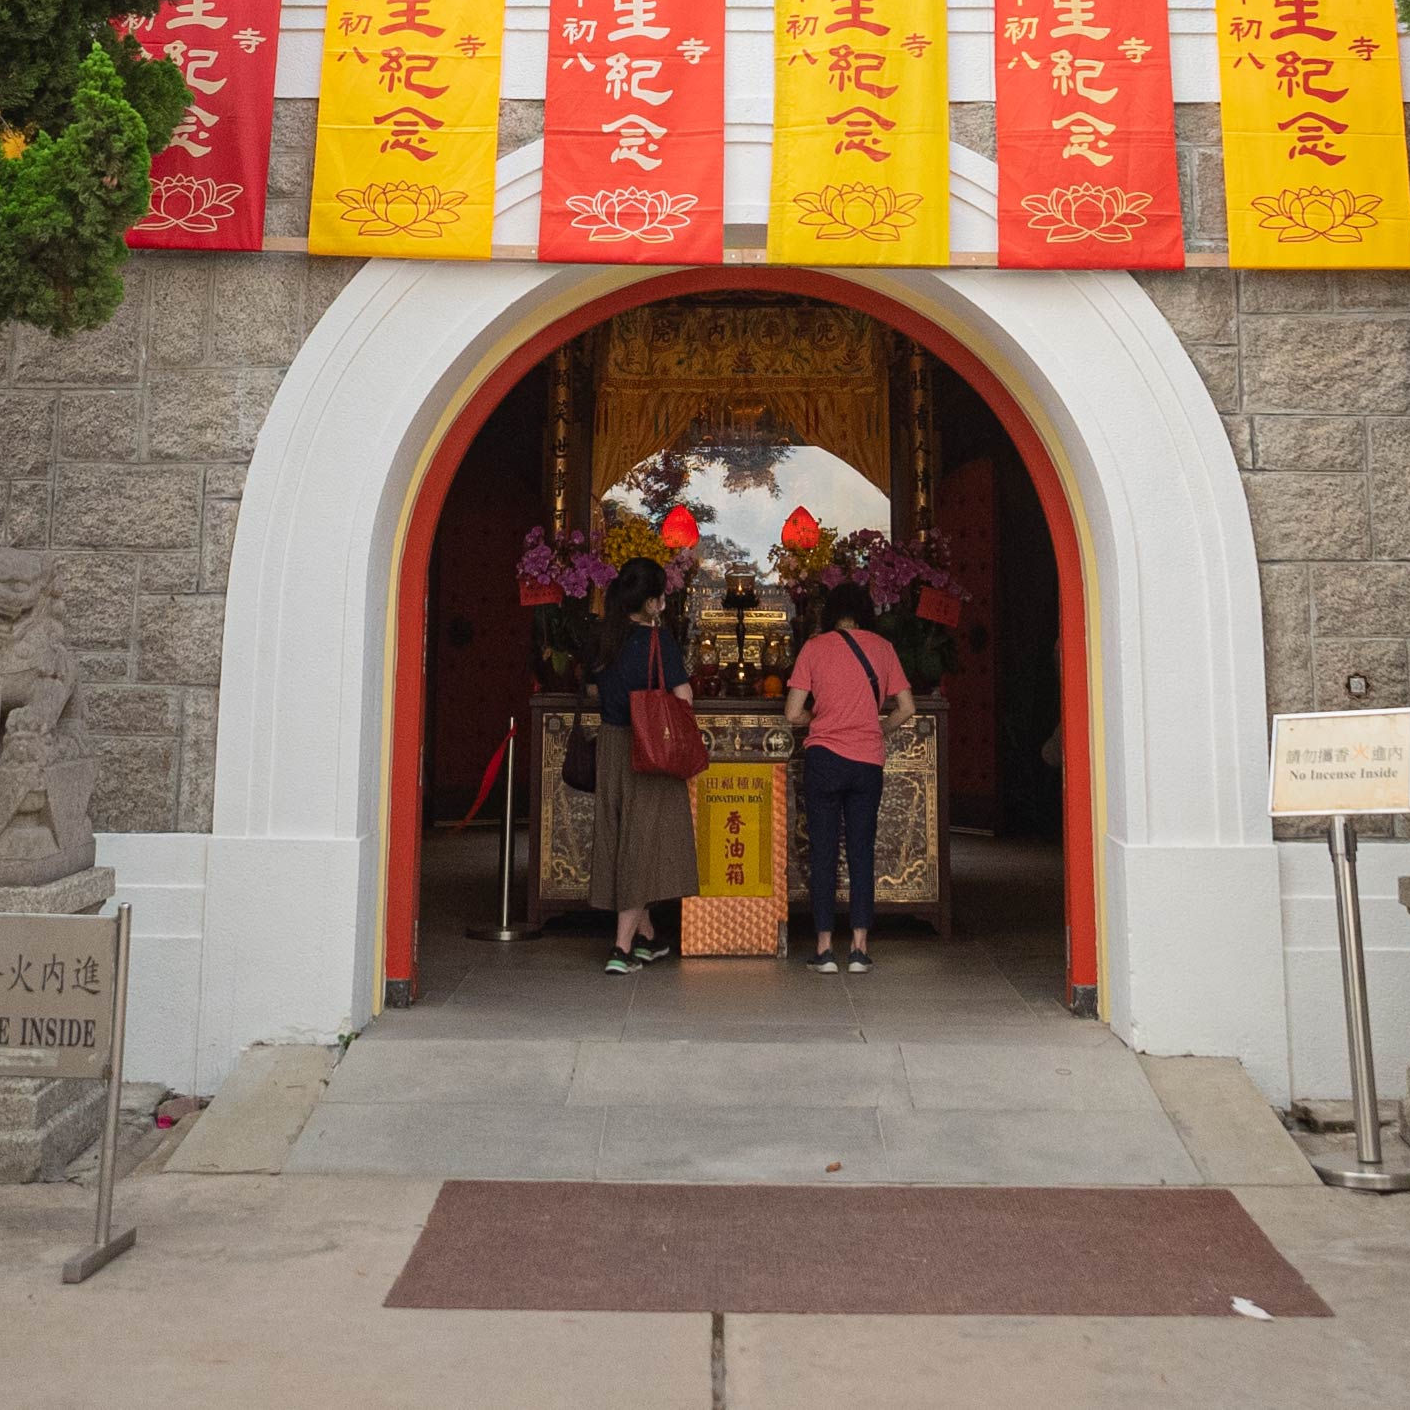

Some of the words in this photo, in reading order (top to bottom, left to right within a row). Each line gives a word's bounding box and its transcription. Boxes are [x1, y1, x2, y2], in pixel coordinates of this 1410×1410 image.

[1290, 770, 1306, 781] No
[1311, 769, 1355, 780] Incense
[1360, 768, 1398, 779] Inside
[706, 794, 745, 803] DONATION
[748, 794, 763, 803] BOX
[724, 811, 746, 885] 香油箱
[20, 1018, 96, 1047] INSIDE
